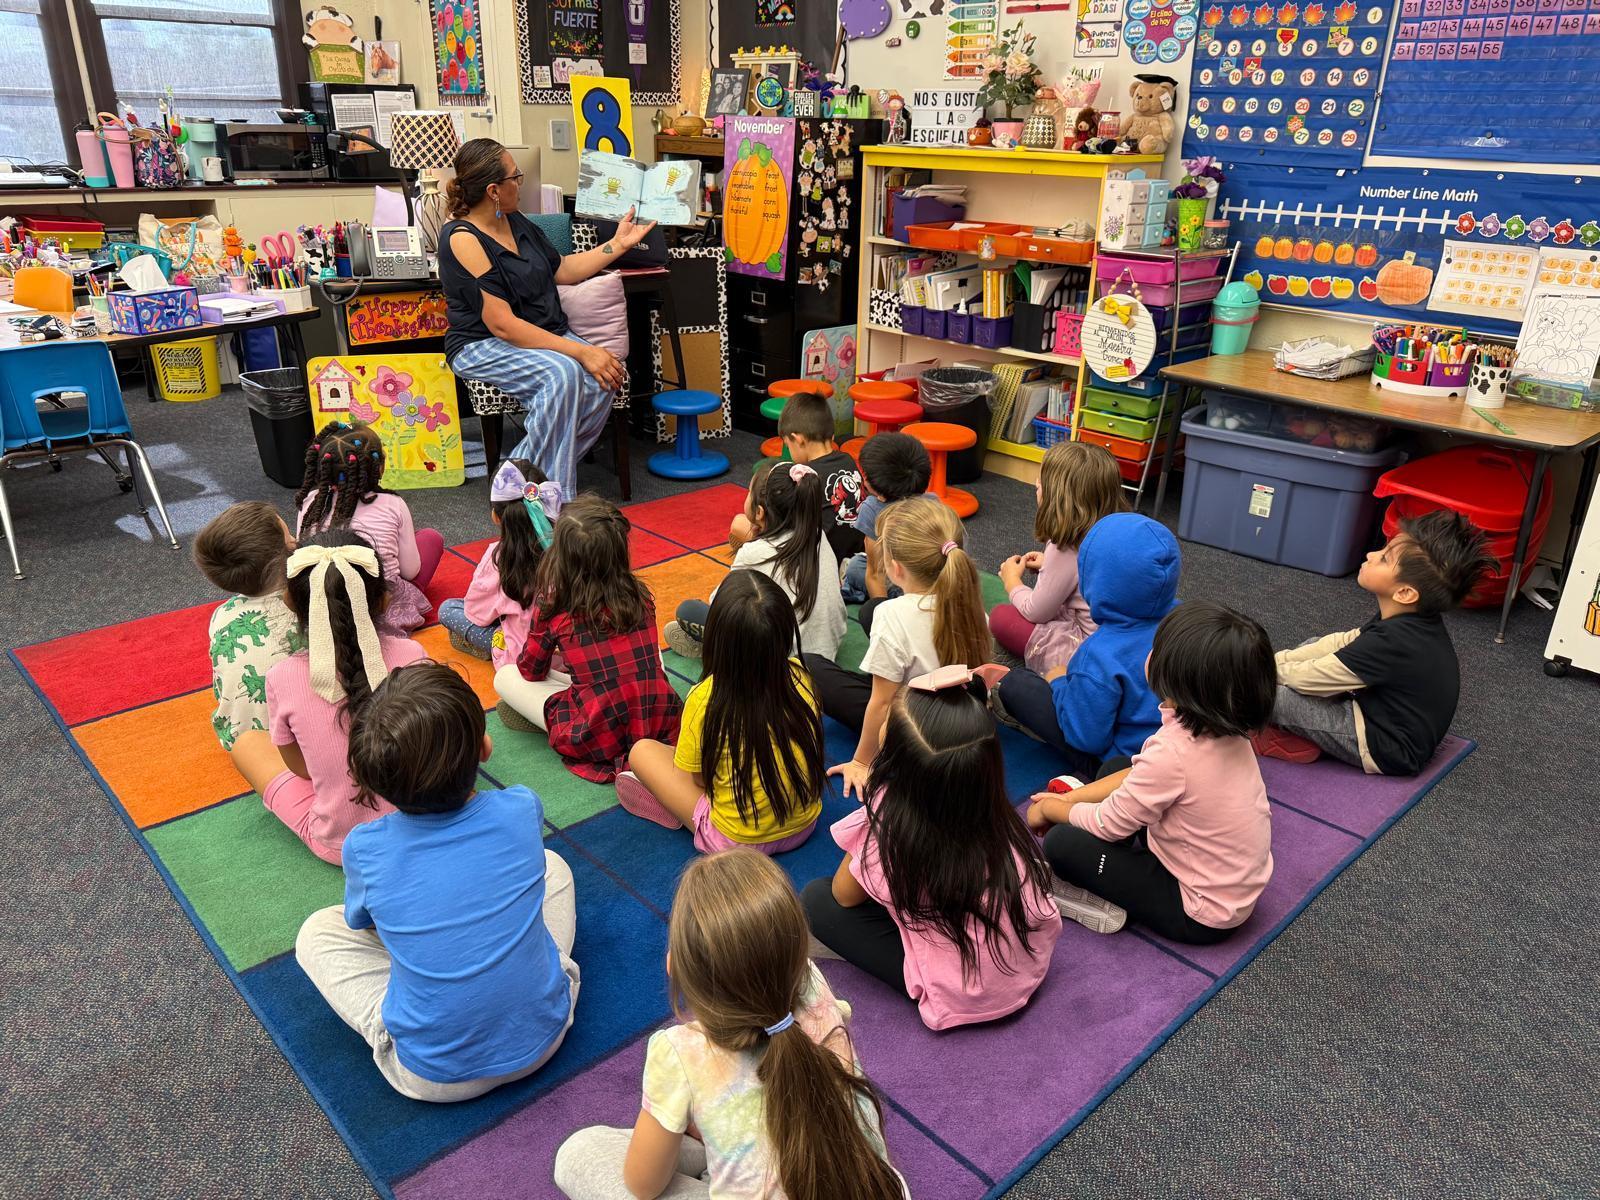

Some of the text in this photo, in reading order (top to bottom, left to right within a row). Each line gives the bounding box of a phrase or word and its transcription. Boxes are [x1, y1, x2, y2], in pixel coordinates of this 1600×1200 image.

[1405, 2, 1418, 12] 31
[1427, 0, 1442, 12] 32
[1446, 0, 1462, 10] 33
[1470, 0, 1486, 10] 34
[1492, 0, 1508, 9] 35
[554, 10, 598, 28] FUERTE
[629, 4, 646, 25] U
[1372, 9, 1378, 20] 1
[1160, 18, 1170, 26] hoy
[1401, 26, 1414, 36] 41
[1422, 22, 1437, 33] 42
[1441, 21, 1457, 32] 43
[1464, 20, 1480, 31] 44
[1487, 20, 1504, 31] 45
[1511, 19, 1528, 30] 46
[1536, 19, 1552, 30] 47
[1560, 18, 1579, 29] 48
[1087, 39, 1117, 48] TARDES!
[1212, 41, 1372, 52] 2 3 4 5 6 7 8
[1398, 44, 1500, 55] 51 52 53 54 55
[1203, 72, 1367, 82] 9 10 11 12 13 14 15
[914, 92, 937, 106] NOS
[794, 105, 814, 116] EVER
[1199, 100, 1362, 112] 16 17 18 19 20 21 22
[936, 112, 954, 125] LA
[734, 119, 784, 135] November
[1198, 127, 1355, 142] 30 24 25 26 27 28 29
[766, 170, 780, 179] feast
[732, 181, 777, 192] vegetables frost
[1360, 186, 1478, 202] Number Line Math
[763, 210, 780, 222] squash
[364, 297, 419, 324] Happy
[350, 314, 450, 340] Thanksgivin
[1098, 324, 1136, 339] BIENVENIDOS
[1098, 338, 1133, 355] Maestra
